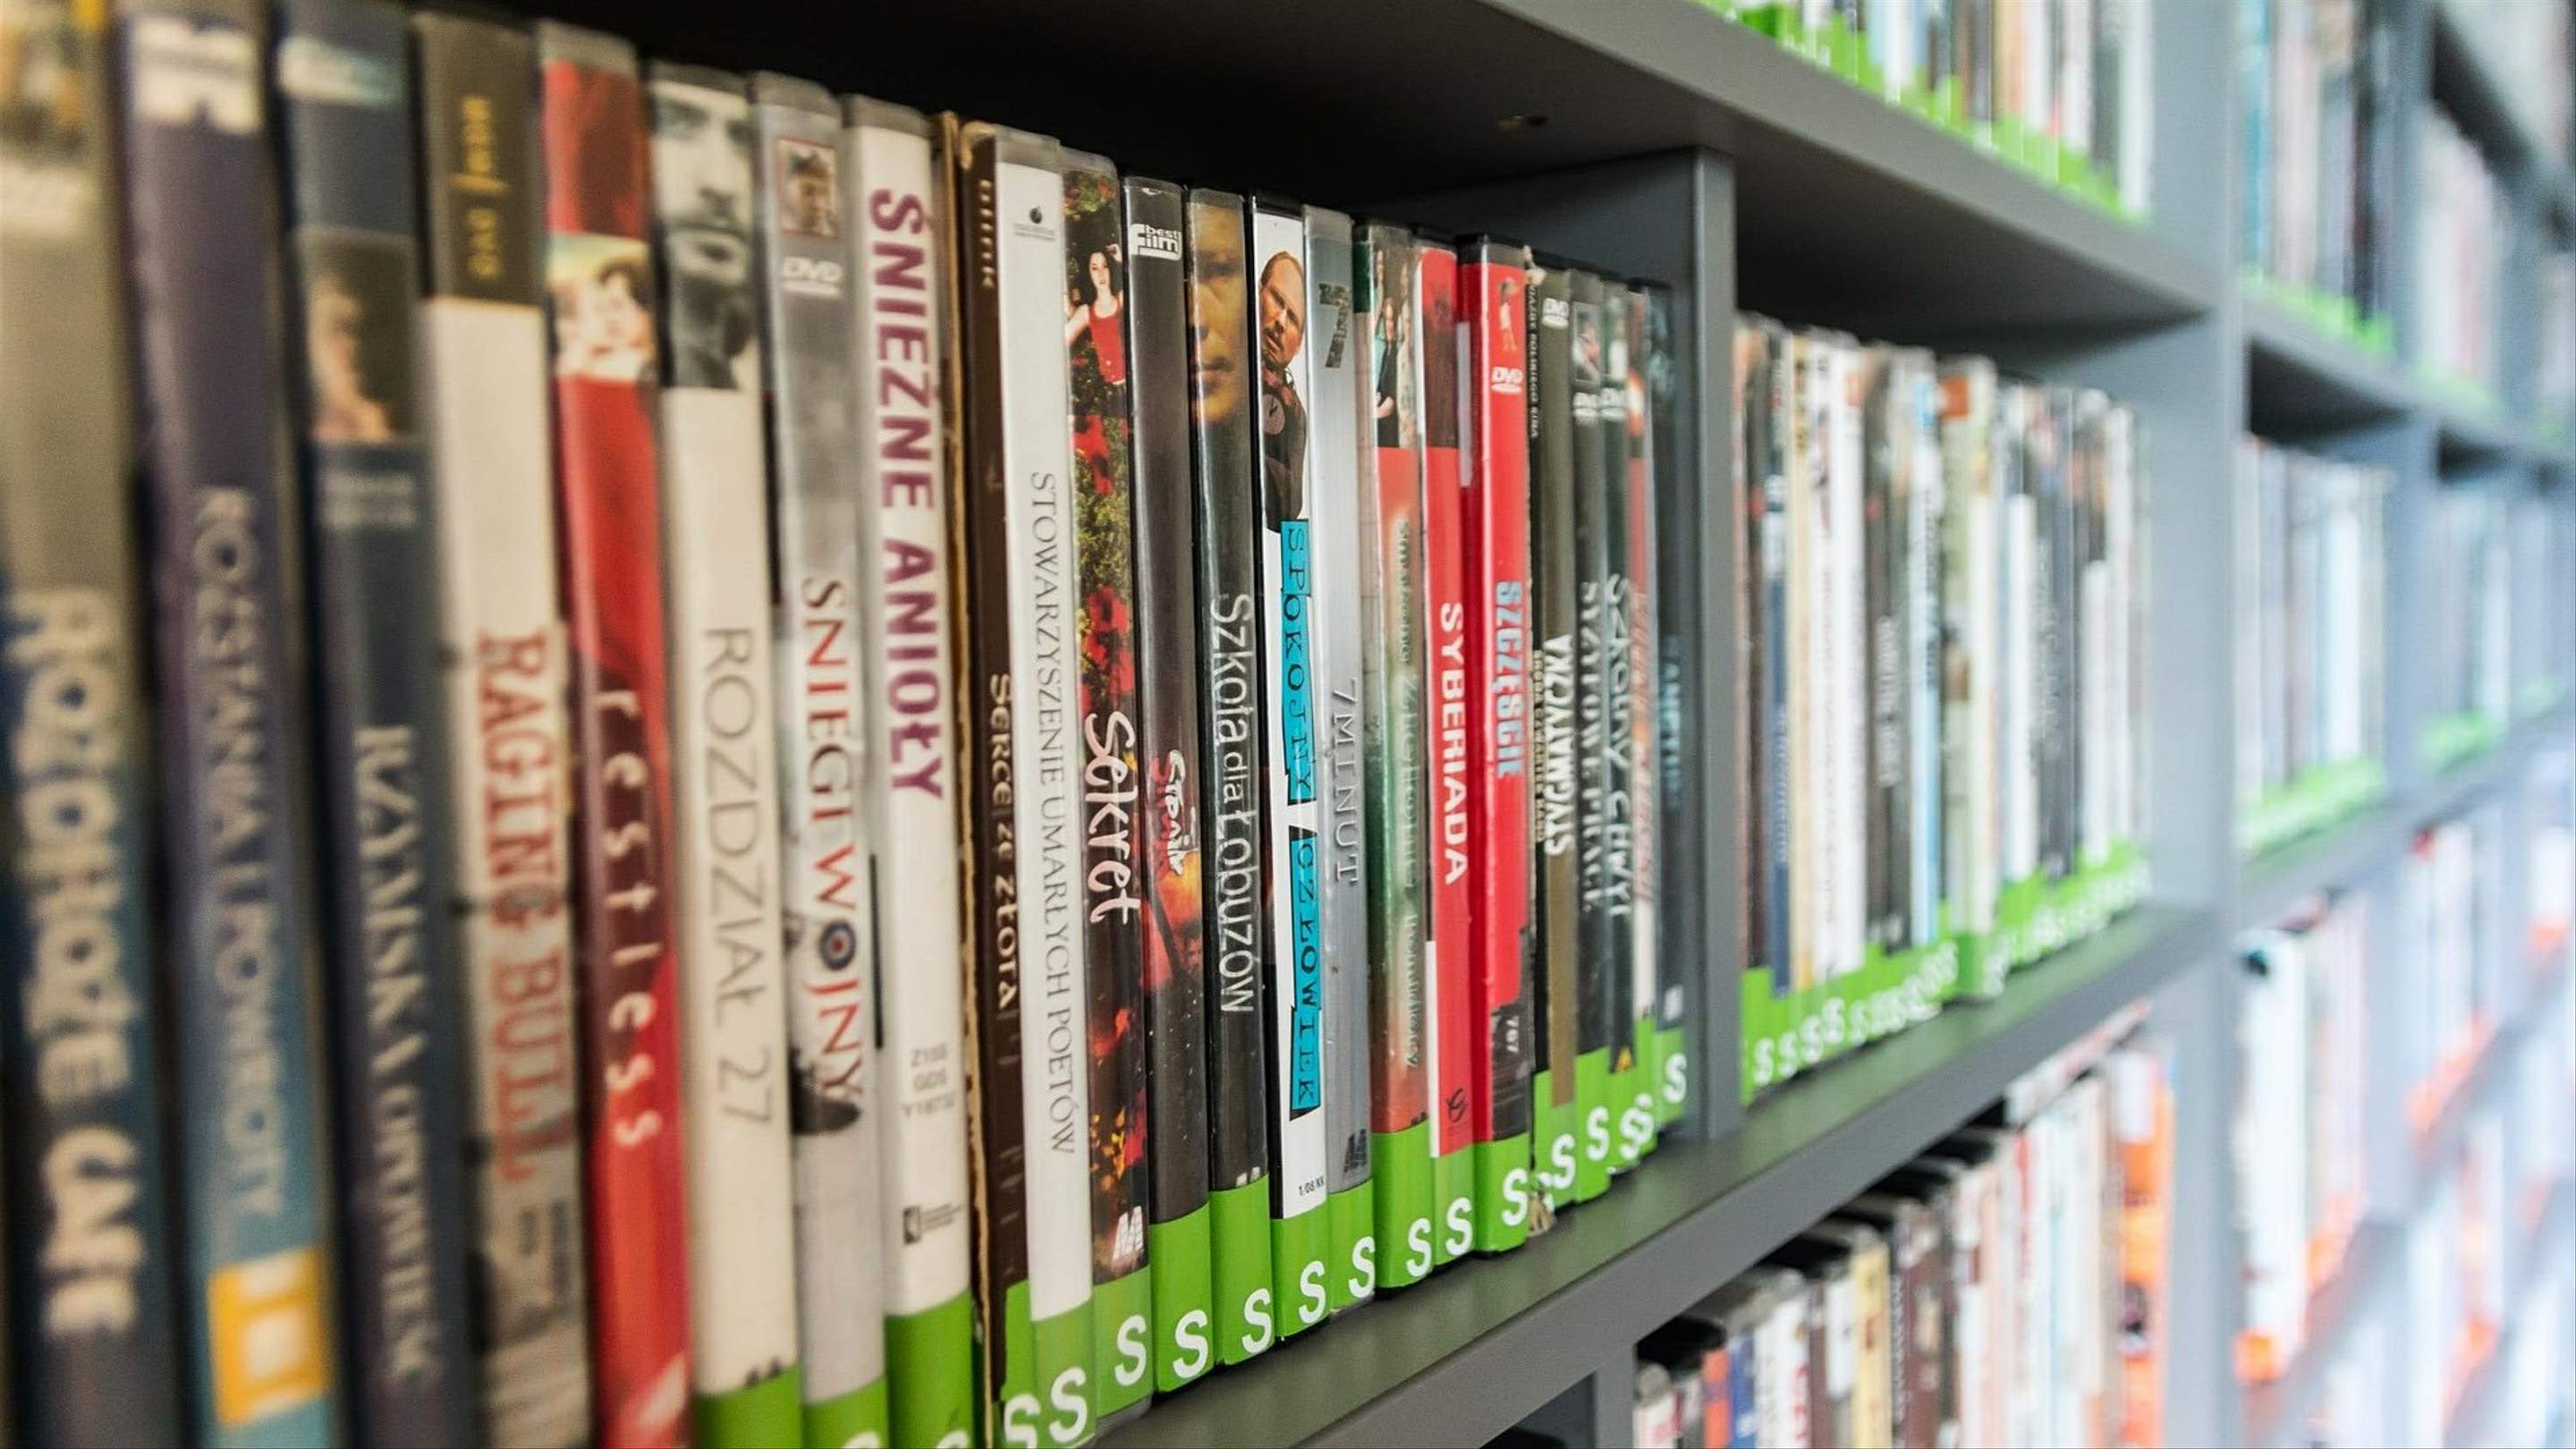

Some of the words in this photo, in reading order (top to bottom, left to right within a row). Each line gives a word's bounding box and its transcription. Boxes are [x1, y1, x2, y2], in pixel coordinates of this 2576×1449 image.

[869, 188, 936, 511] ŚNIEŻNE
[1318, 283, 1352, 369] 7
[882, 538, 945, 801] ANIOŁY
[1030, 470, 1065, 788] STOWARZYSZENIE
[1208, 592, 1254, 744] Szkoła
[1282, 528, 1317, 794] SPOKOJNY
[1333, 677, 1358, 708] 7
[477, 629, 562, 931] RAGING
[1222, 746, 1245, 806] dla
[1439, 601, 1470, 886] SYBERIADA
[701, 626, 769, 1029] ROZDZIAŁ
[1083, 709, 1140, 926] Sekret
[1334, 712, 1359, 887] MINUT
[1042, 794, 1071, 997] UMARŁYCH
[1213, 808, 1260, 1013] Łobuzów
[488, 953, 572, 1182] BULL
[718, 1043, 774, 1127] 27
[1046, 1004, 1079, 1155] POETÓW
[1551, 1132, 1576, 1191] S
[1587, 1106, 1609, 1162] S
[1445, 1196, 1473, 1257] S
[1502, 1167, 1530, 1226] S
[1348, 1235, 1376, 1299] S
[1406, 1216, 1431, 1278] S
[1241, 1286, 1272, 1354] S
[1299, 1259, 1327, 1325] S
[1114, 1313, 1148, 1386] S
[1173, 1309, 1209, 1380] S
[1048, 1365, 1089, 1445] S
